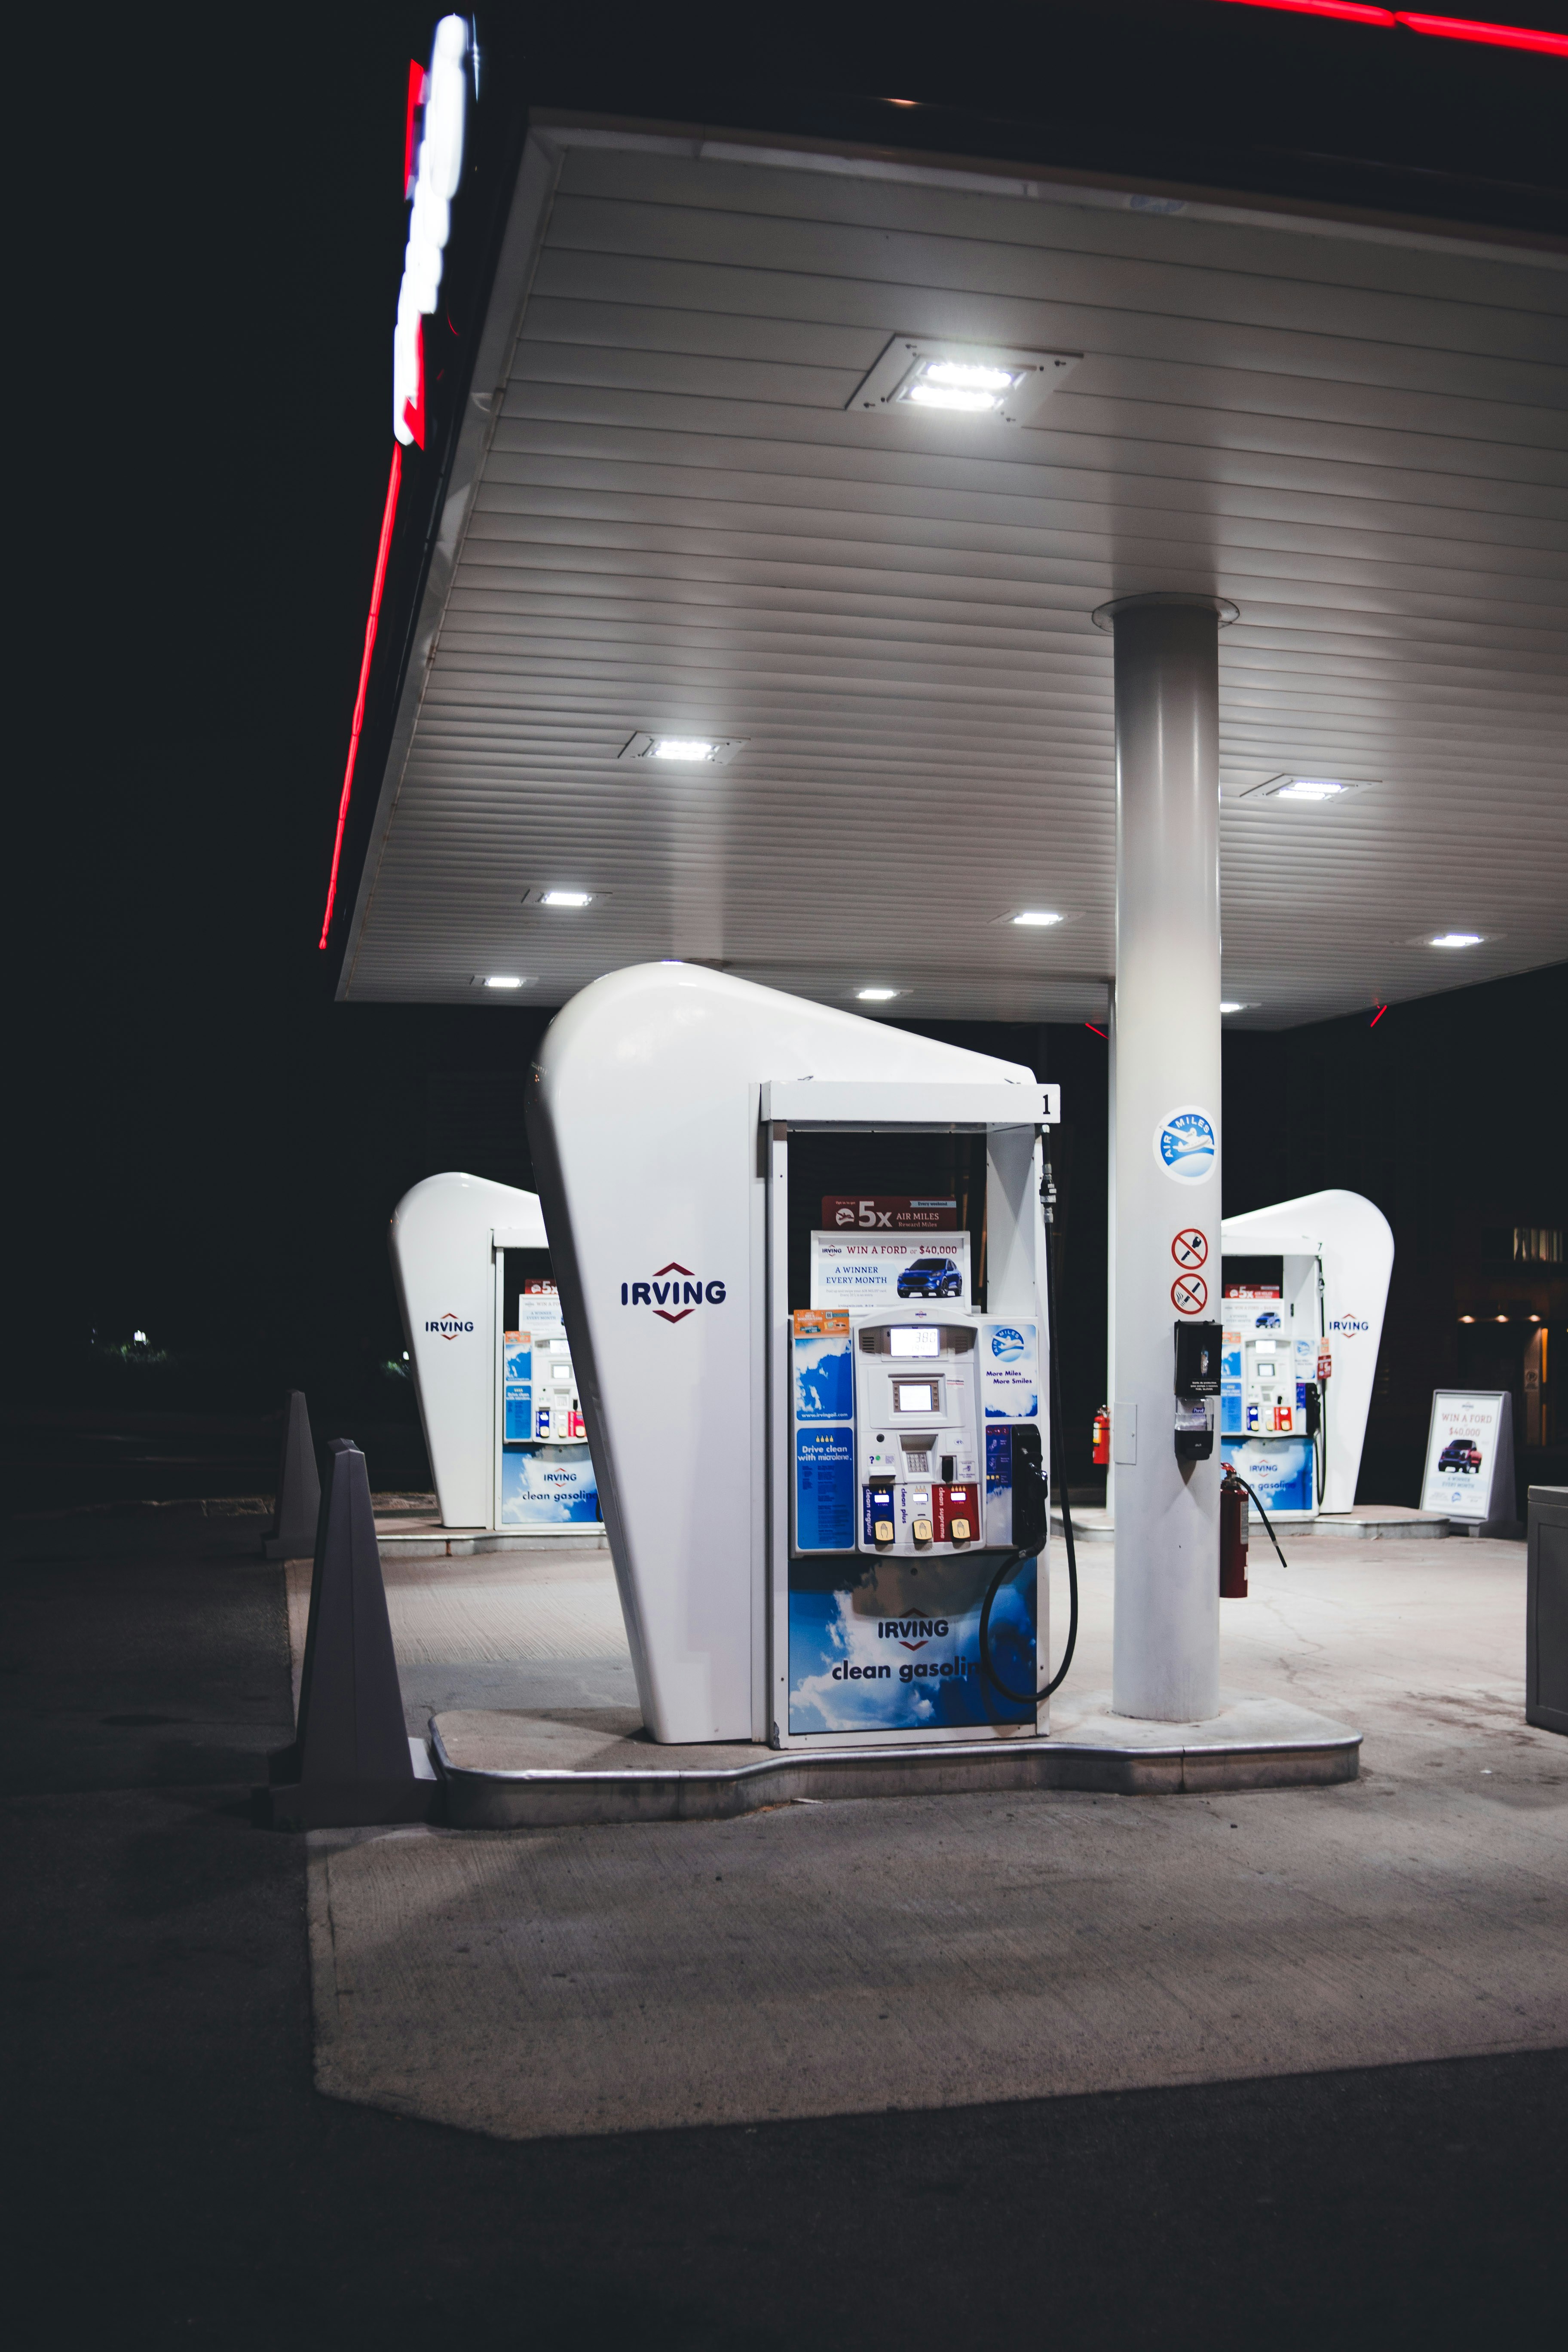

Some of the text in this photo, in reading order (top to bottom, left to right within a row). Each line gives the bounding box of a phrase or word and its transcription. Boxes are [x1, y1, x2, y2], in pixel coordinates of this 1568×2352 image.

[1043, 1094, 1050, 1115] 1
[1163, 1116, 1210, 1158] AIR MILES
[859, 1200, 893, 1228] 5x
[846, 1246, 869, 1254] WIN
[881, 1246, 907, 1254] FORD
[919, 1245, 957, 1255] $40,000
[1317, 1242, 1323, 1252] 7
[542, 1281, 559, 1294] 5x
[621, 1280, 727, 1306] IRVING
[1238, 1286, 1254, 1298] 5x
[425, 1321, 474, 1332] IRVING
[1329, 1321, 1369, 1331] IRVING
[999, 1330, 1019, 1339] MILES
[1442, 1413, 1492, 1424] WIN A FORD
[1449, 1427, 1481, 1437] $40,000
[802, 1444, 848, 1454] Drive clean
[523, 1491, 550, 1500] clean
[900, 1509, 908, 1524] plus
[865, 1509, 873, 1537] regular
[878, 1620, 949, 1638] IRVING
[832, 1656, 981, 1683] clean gasolin
